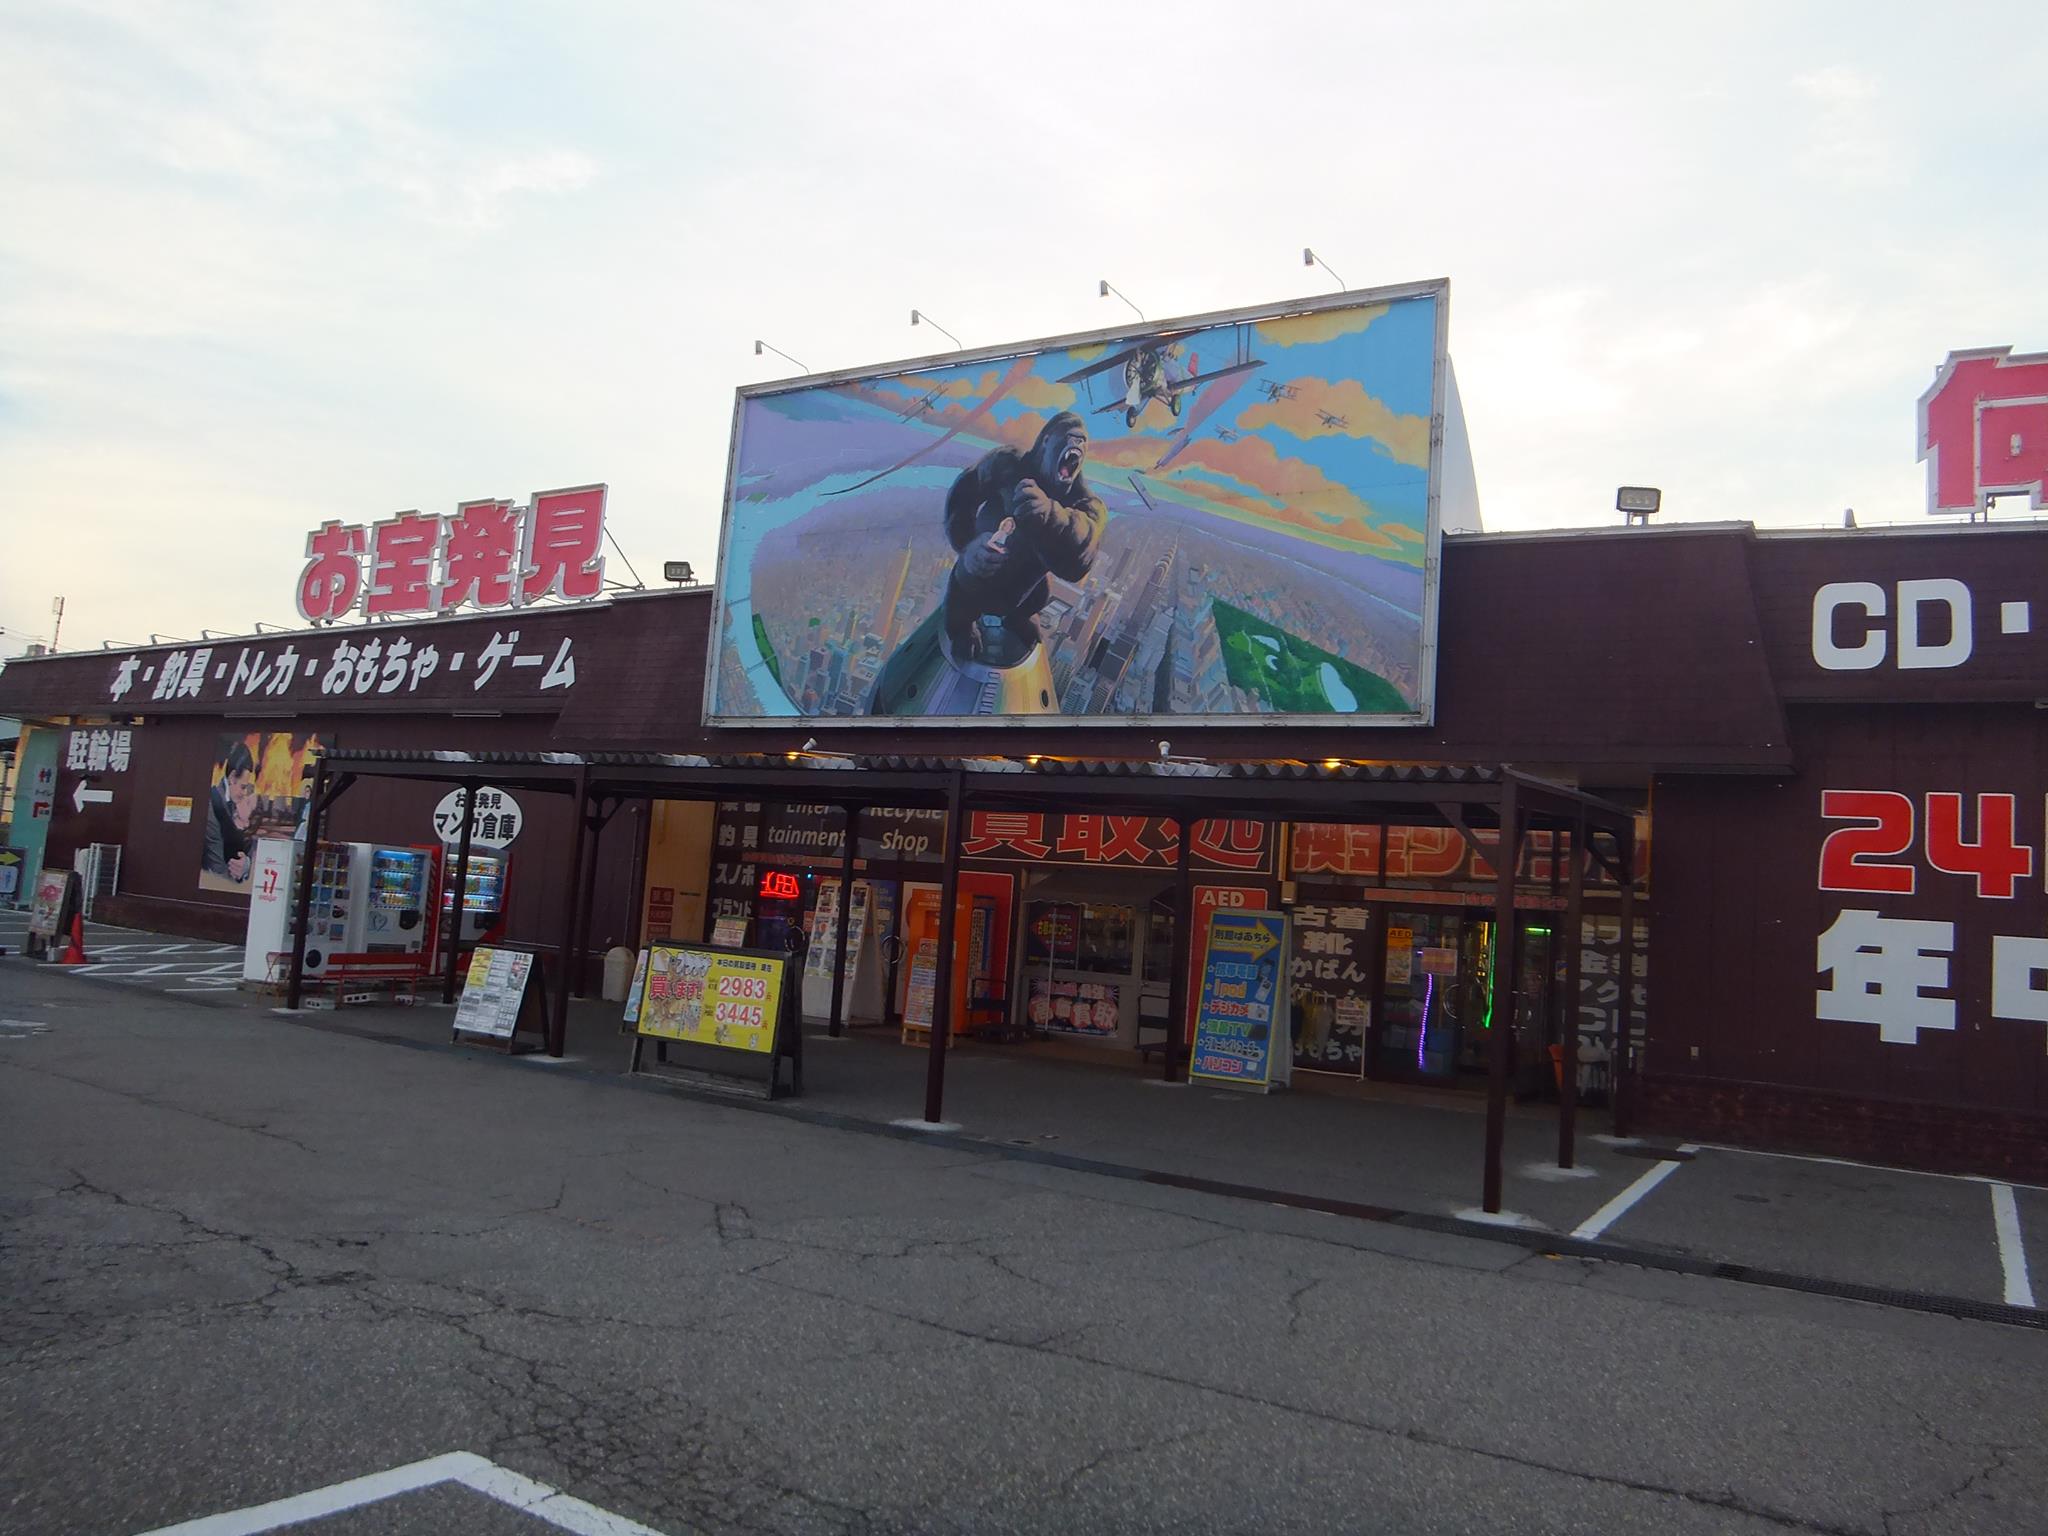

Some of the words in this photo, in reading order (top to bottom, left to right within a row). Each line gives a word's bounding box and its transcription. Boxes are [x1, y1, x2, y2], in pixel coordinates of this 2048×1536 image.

[296, 482, 608, 620] お宝発見
[66, 730, 132, 772] 駐輪場
[455, 792, 501, 809] お発見
[767, 825, 847, 848] tainment
[1818, 789, 2048, 900] 24
[1201, 890, 1245, 907] AED
[1291, 905, 1370, 930] 古着
[1389, 929, 1411, 937] AED
[1290, 956, 1366, 983] かばん
[719, 977, 766, 999] 2983
[715, 1003, 761, 1026] 3445
